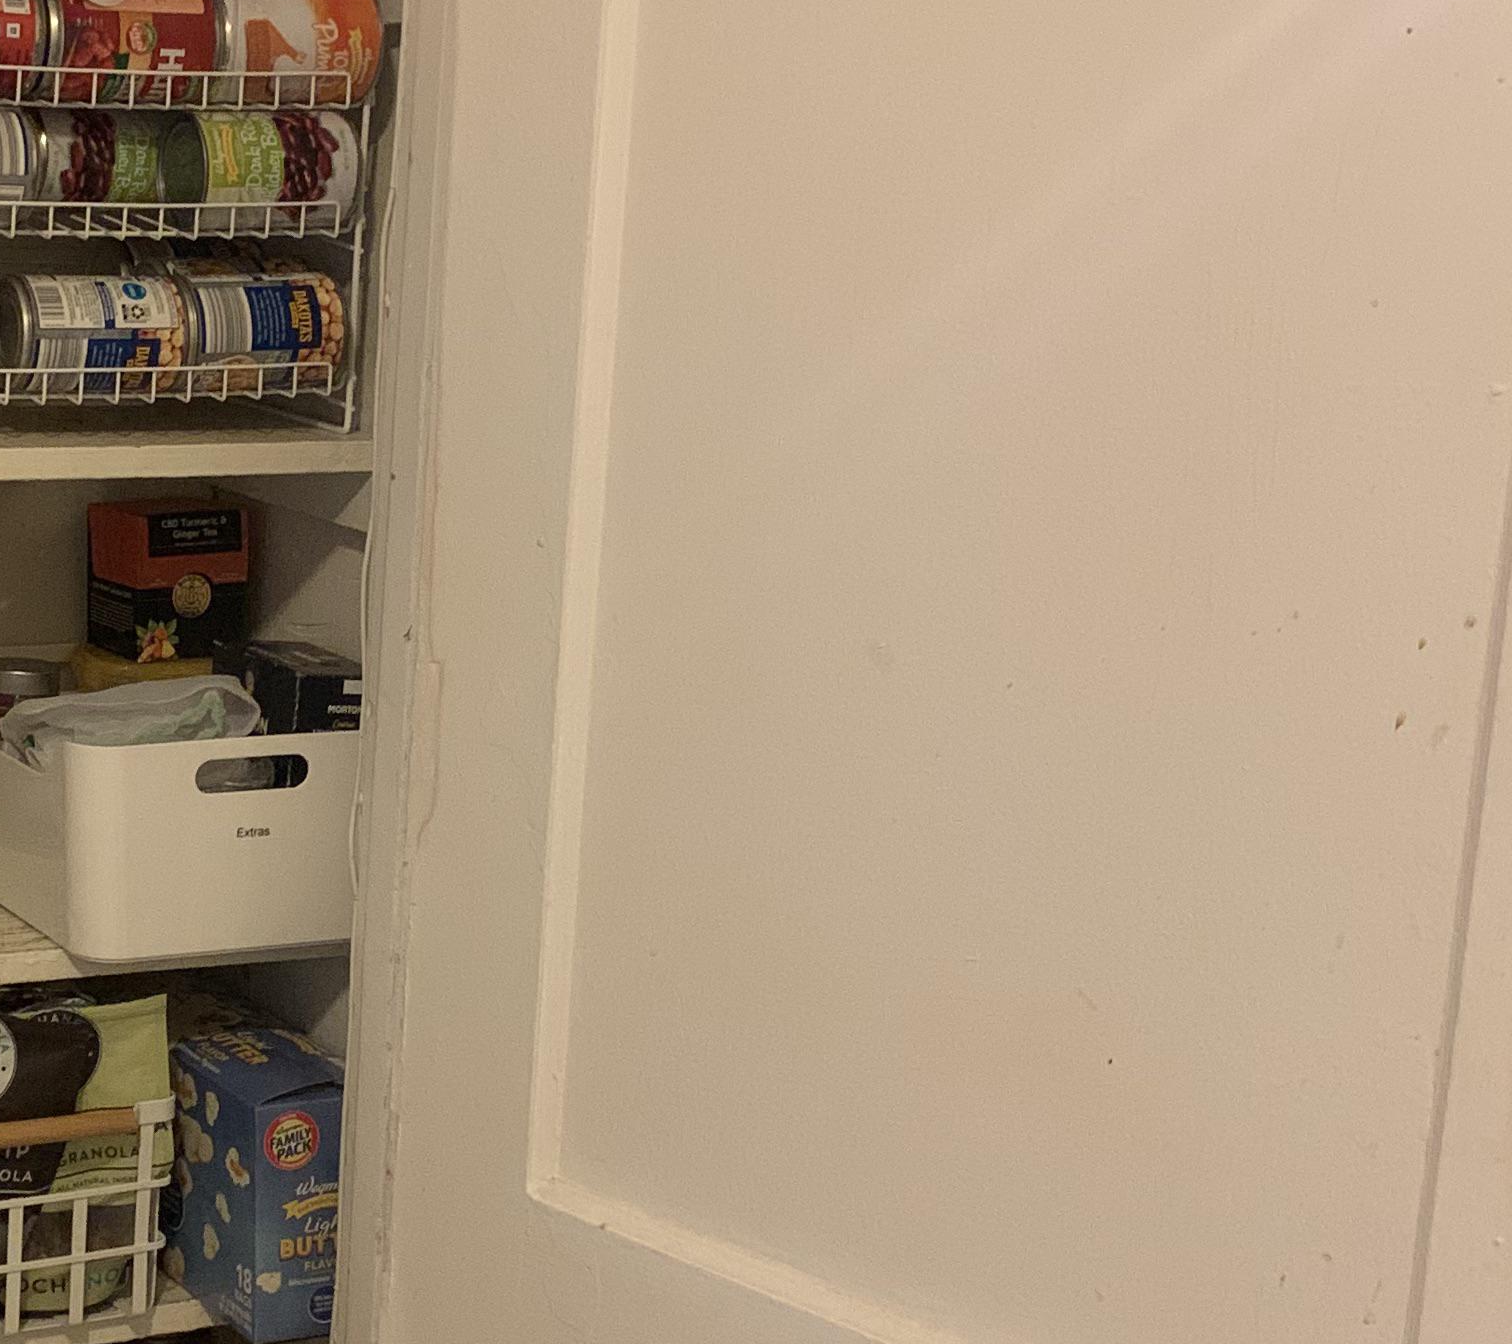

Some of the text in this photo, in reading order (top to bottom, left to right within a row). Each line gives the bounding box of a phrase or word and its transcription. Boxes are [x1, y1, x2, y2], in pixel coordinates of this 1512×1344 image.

[236, 827, 271, 838] Extras
[270, 1126, 312, 1149] FAMILY
[58, 1145, 139, 1168] GRANOLA
[277, 1138, 313, 1161] PACK
[303, 1215, 337, 1241] Ligh
[279, 1233, 339, 1262] BUTT
[236, 1263, 253, 1295] 18
